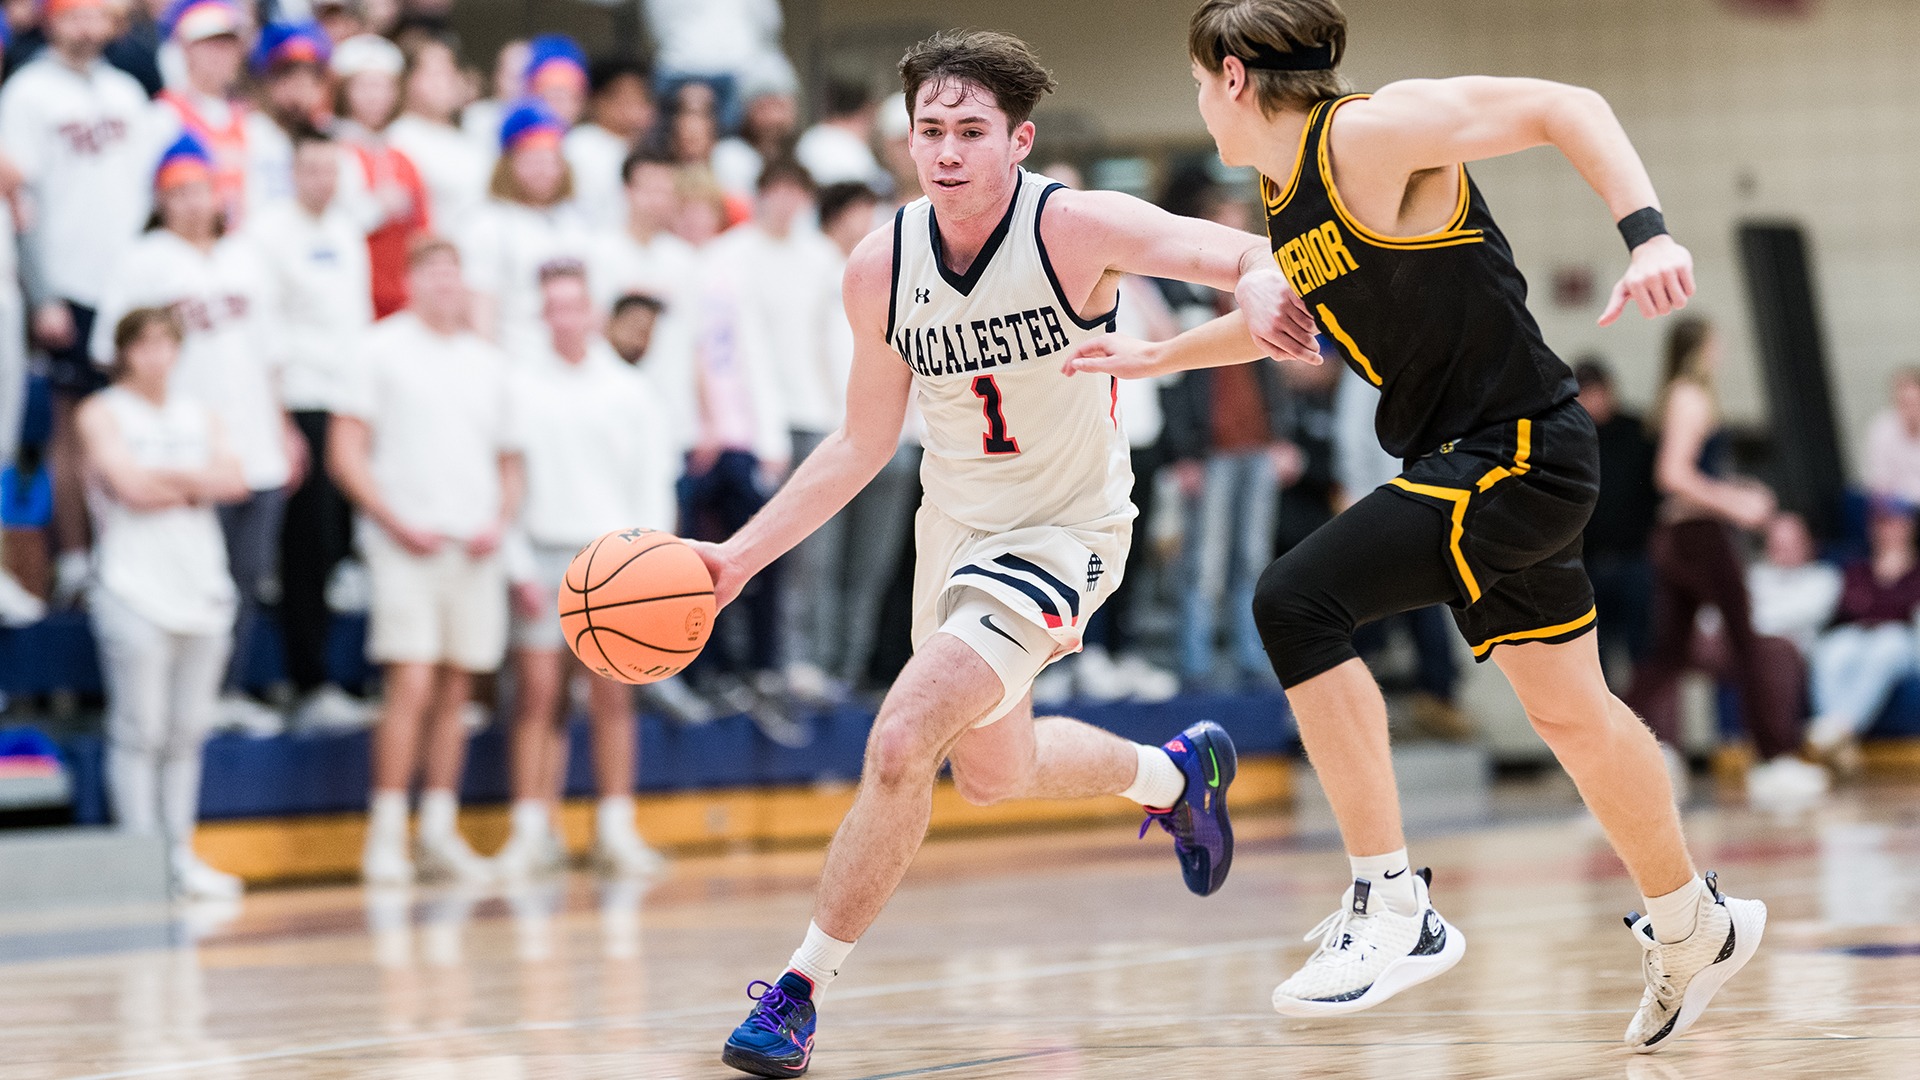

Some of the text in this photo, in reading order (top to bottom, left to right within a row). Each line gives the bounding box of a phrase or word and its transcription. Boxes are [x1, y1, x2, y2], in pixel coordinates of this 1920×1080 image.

[895, 305, 1070, 377] MACALESTER
[1316, 303, 1383, 386] 1
[970, 374, 1021, 455] 1
